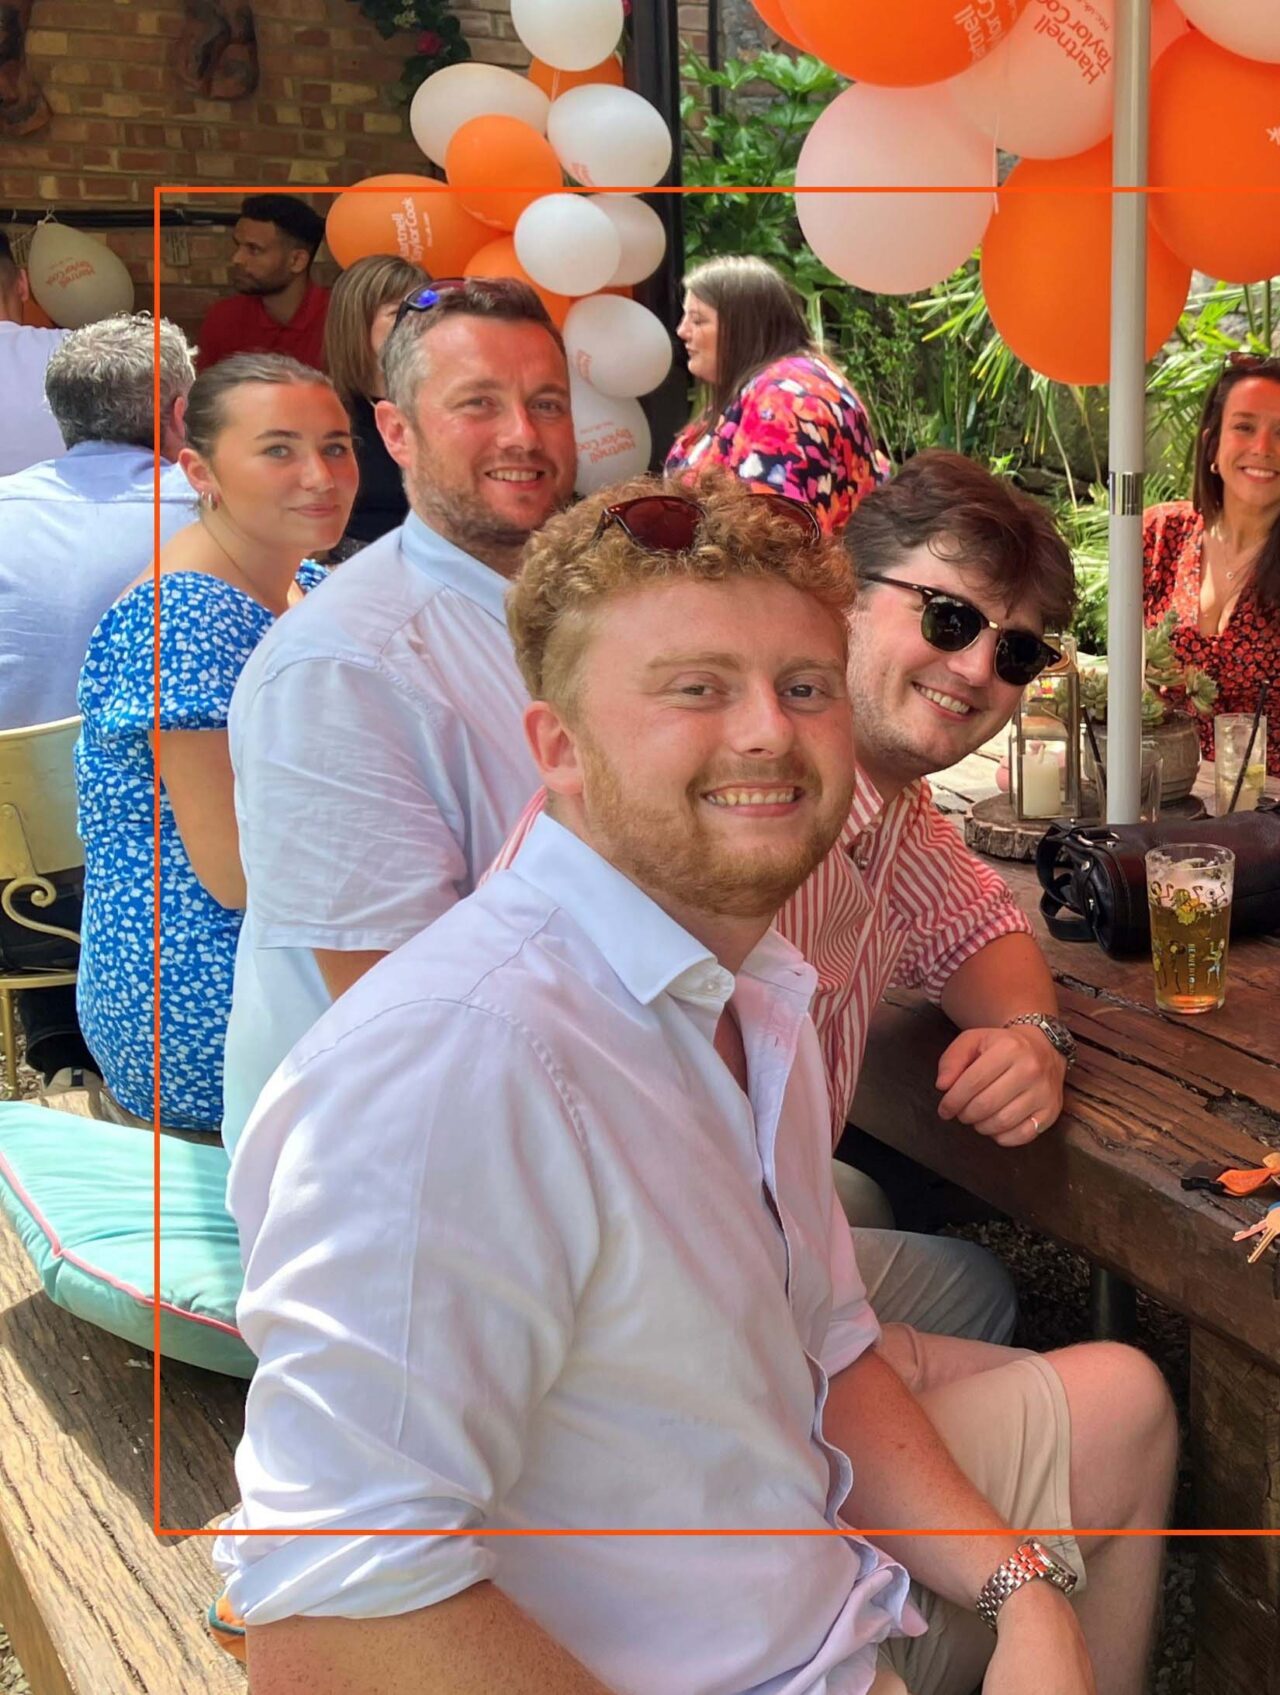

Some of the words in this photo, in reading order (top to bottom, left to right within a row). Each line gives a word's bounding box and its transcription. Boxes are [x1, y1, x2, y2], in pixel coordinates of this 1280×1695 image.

[1035, 0, 1071, 24] Co
[1034, 14, 1100, 85] Hartnell
[1067, 20, 1112, 75] Taylor
